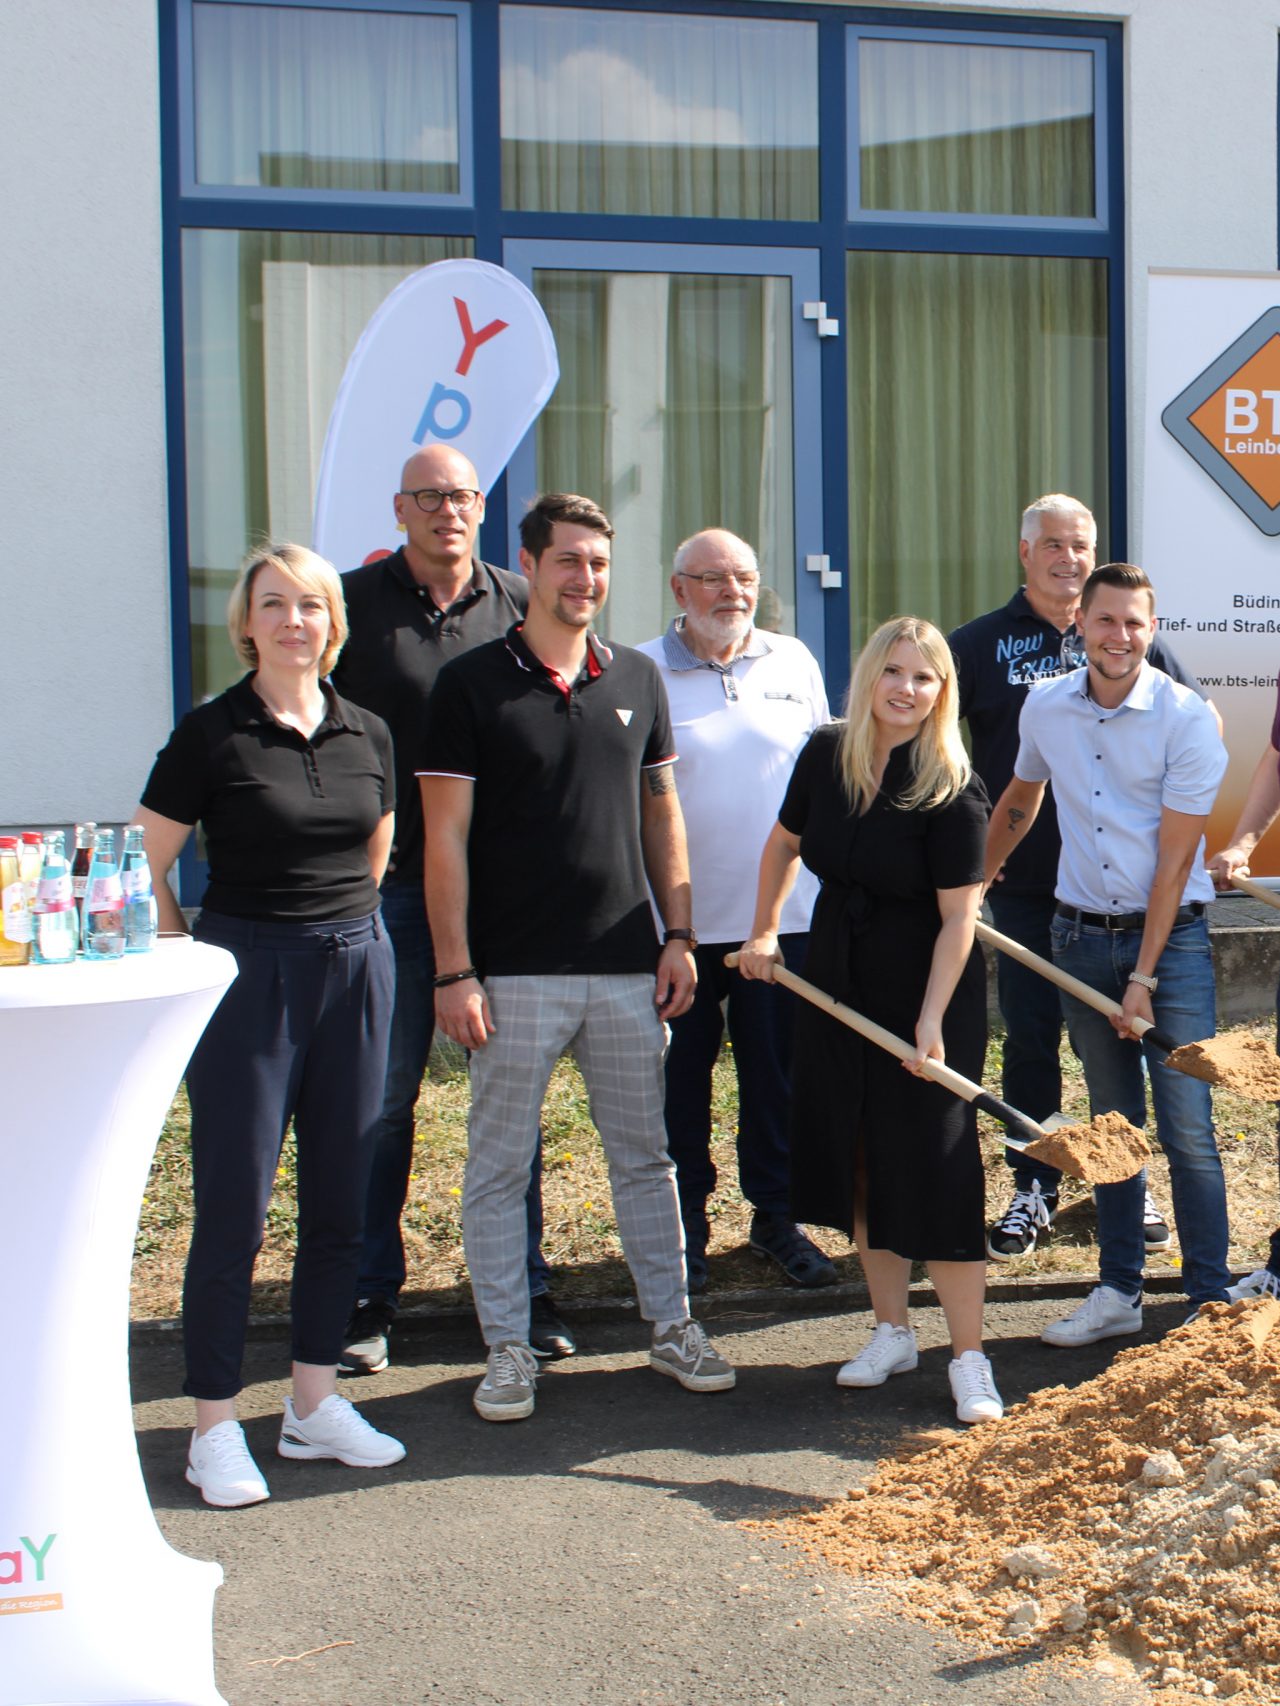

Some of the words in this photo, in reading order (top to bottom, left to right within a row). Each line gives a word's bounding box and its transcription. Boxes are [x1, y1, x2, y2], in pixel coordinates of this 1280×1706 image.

[1157, 617, 1192, 631] Tief-
[1197, 619, 1227, 632] und
[996, 632, 1043, 663] New
[1196, 675, 1279, 687] ww.bts-lein
